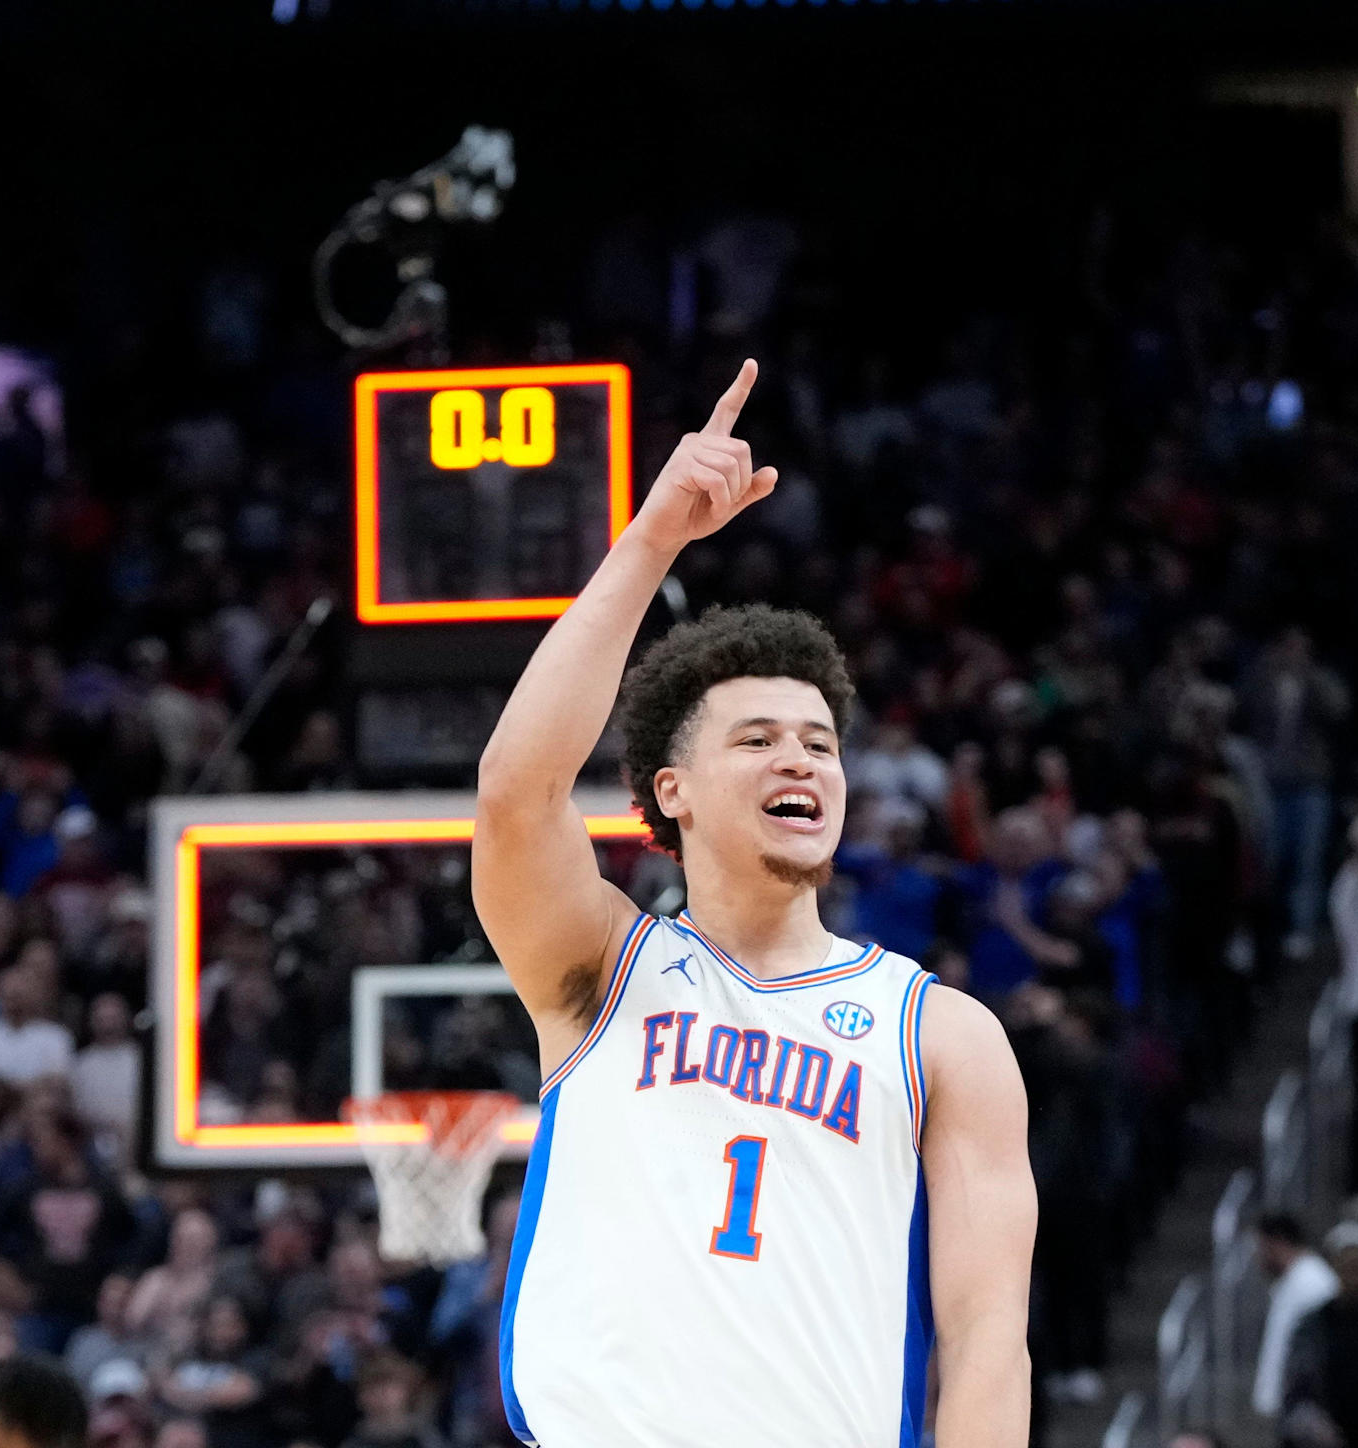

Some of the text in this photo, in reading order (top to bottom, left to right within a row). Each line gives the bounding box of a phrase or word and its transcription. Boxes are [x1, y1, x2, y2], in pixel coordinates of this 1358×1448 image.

[430, 386, 556, 470] 0.0
[825, 1002, 872, 1038] SEC
[635, 1010, 863, 1145] FLORIDA
[708, 1134, 768, 1262] 1
